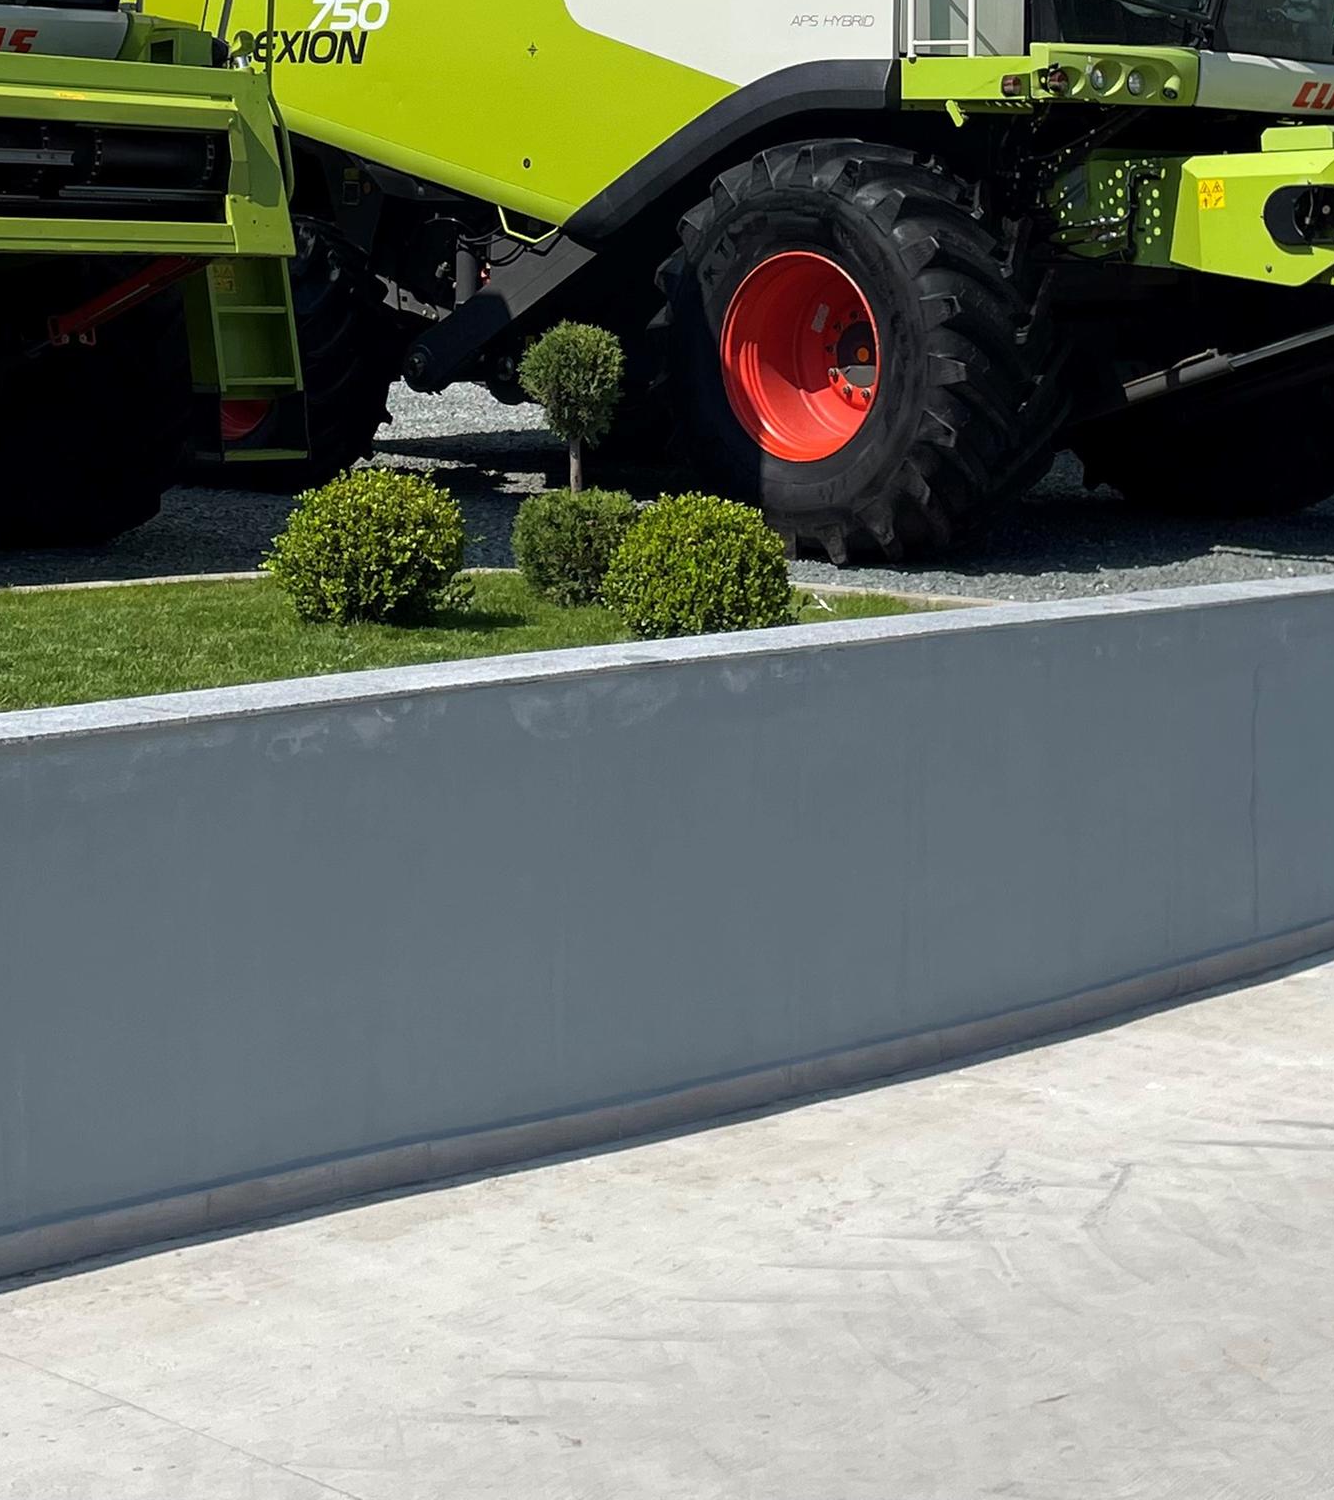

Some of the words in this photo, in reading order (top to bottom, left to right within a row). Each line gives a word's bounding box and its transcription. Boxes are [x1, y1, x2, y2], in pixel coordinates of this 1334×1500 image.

[790, 14, 819, 27] APS
[823, 14, 875, 28] HYBRID
[249, 30, 368, 64] EXION
